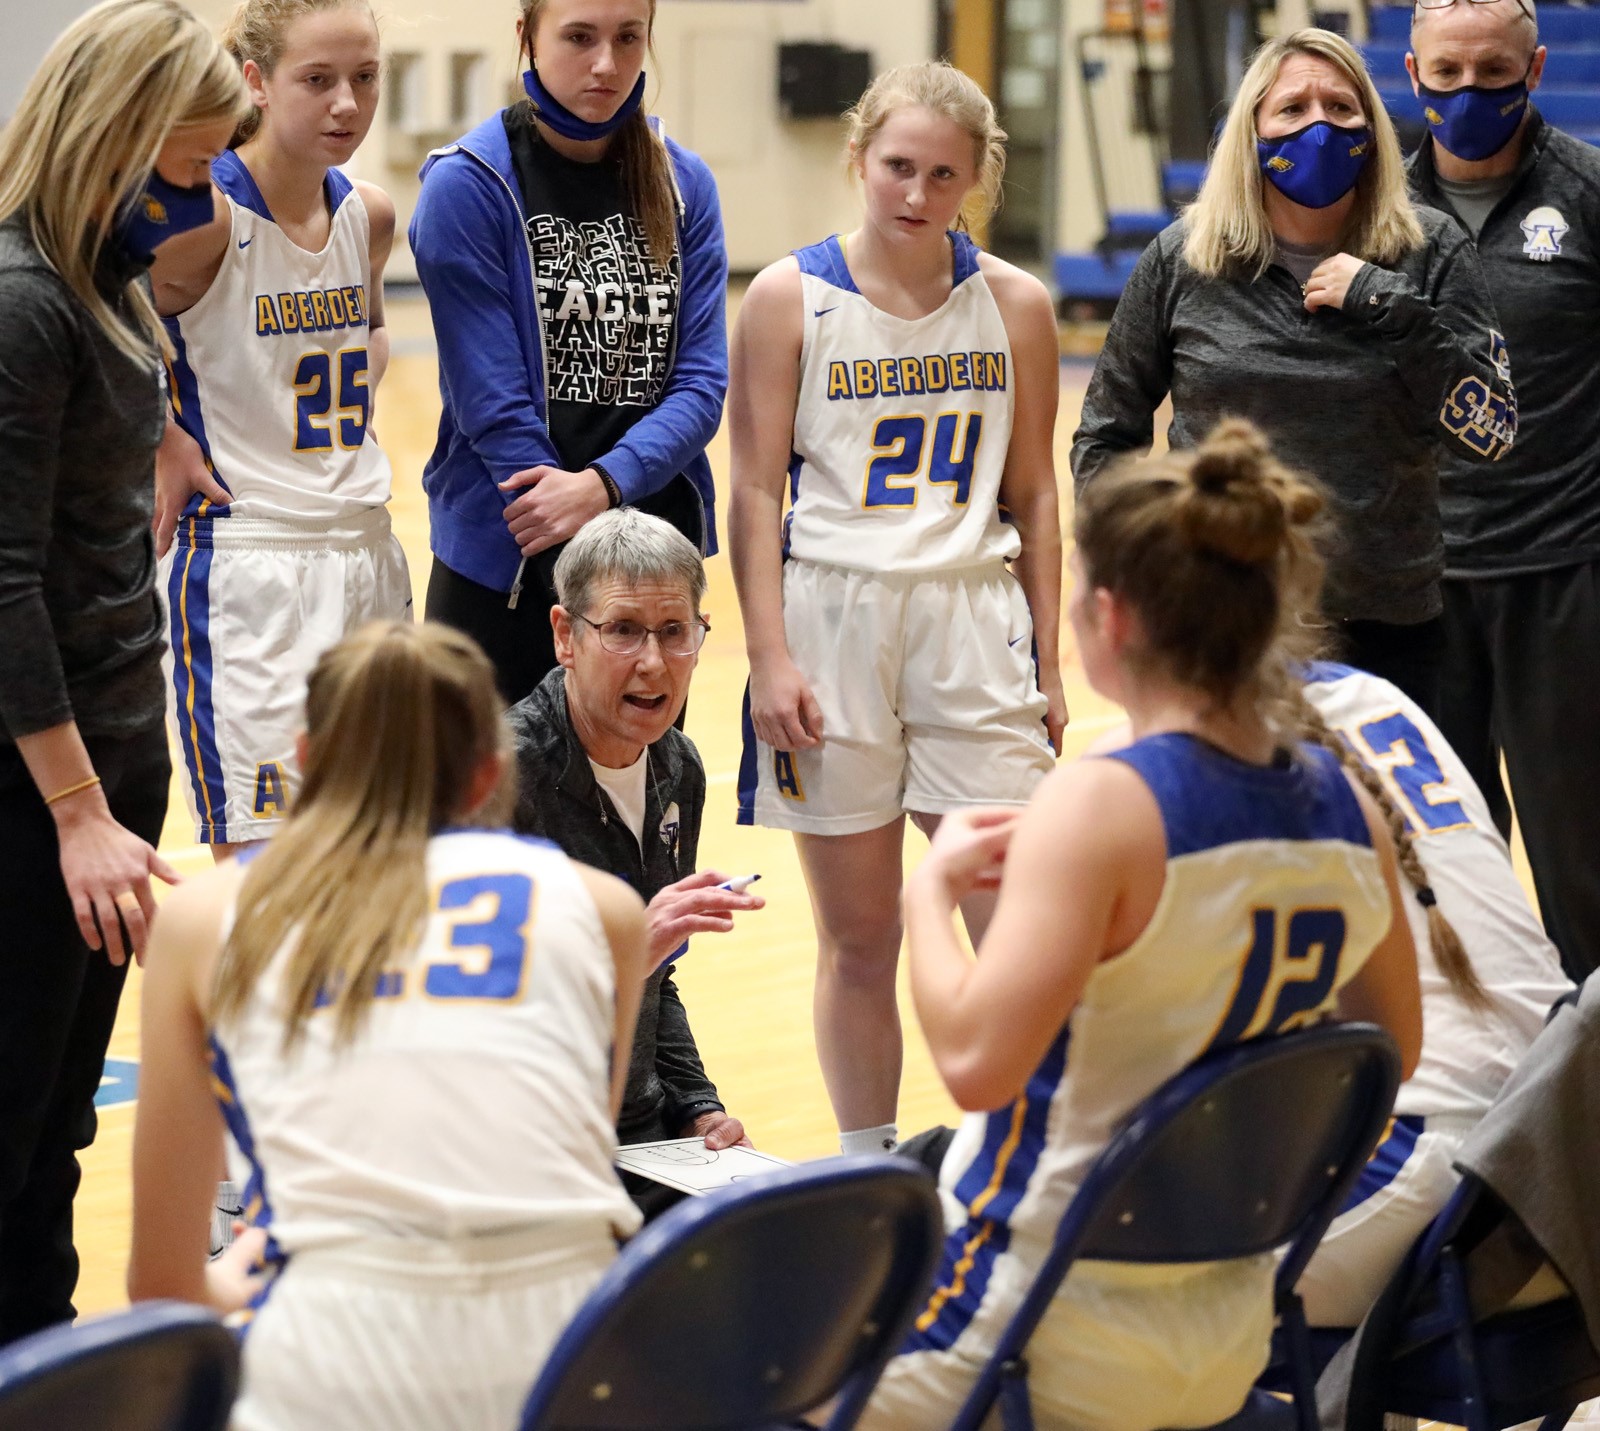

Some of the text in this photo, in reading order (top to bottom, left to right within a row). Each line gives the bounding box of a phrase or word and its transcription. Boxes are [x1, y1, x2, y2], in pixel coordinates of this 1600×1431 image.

[291, 346, 369, 454] 25
[827, 351, 1007, 401] ABERDEEN
[861, 410, 984, 511] 24
[251, 760, 290, 820] A
[1332, 711, 1477, 839] 2
[1195, 903, 1348, 1056] 12
